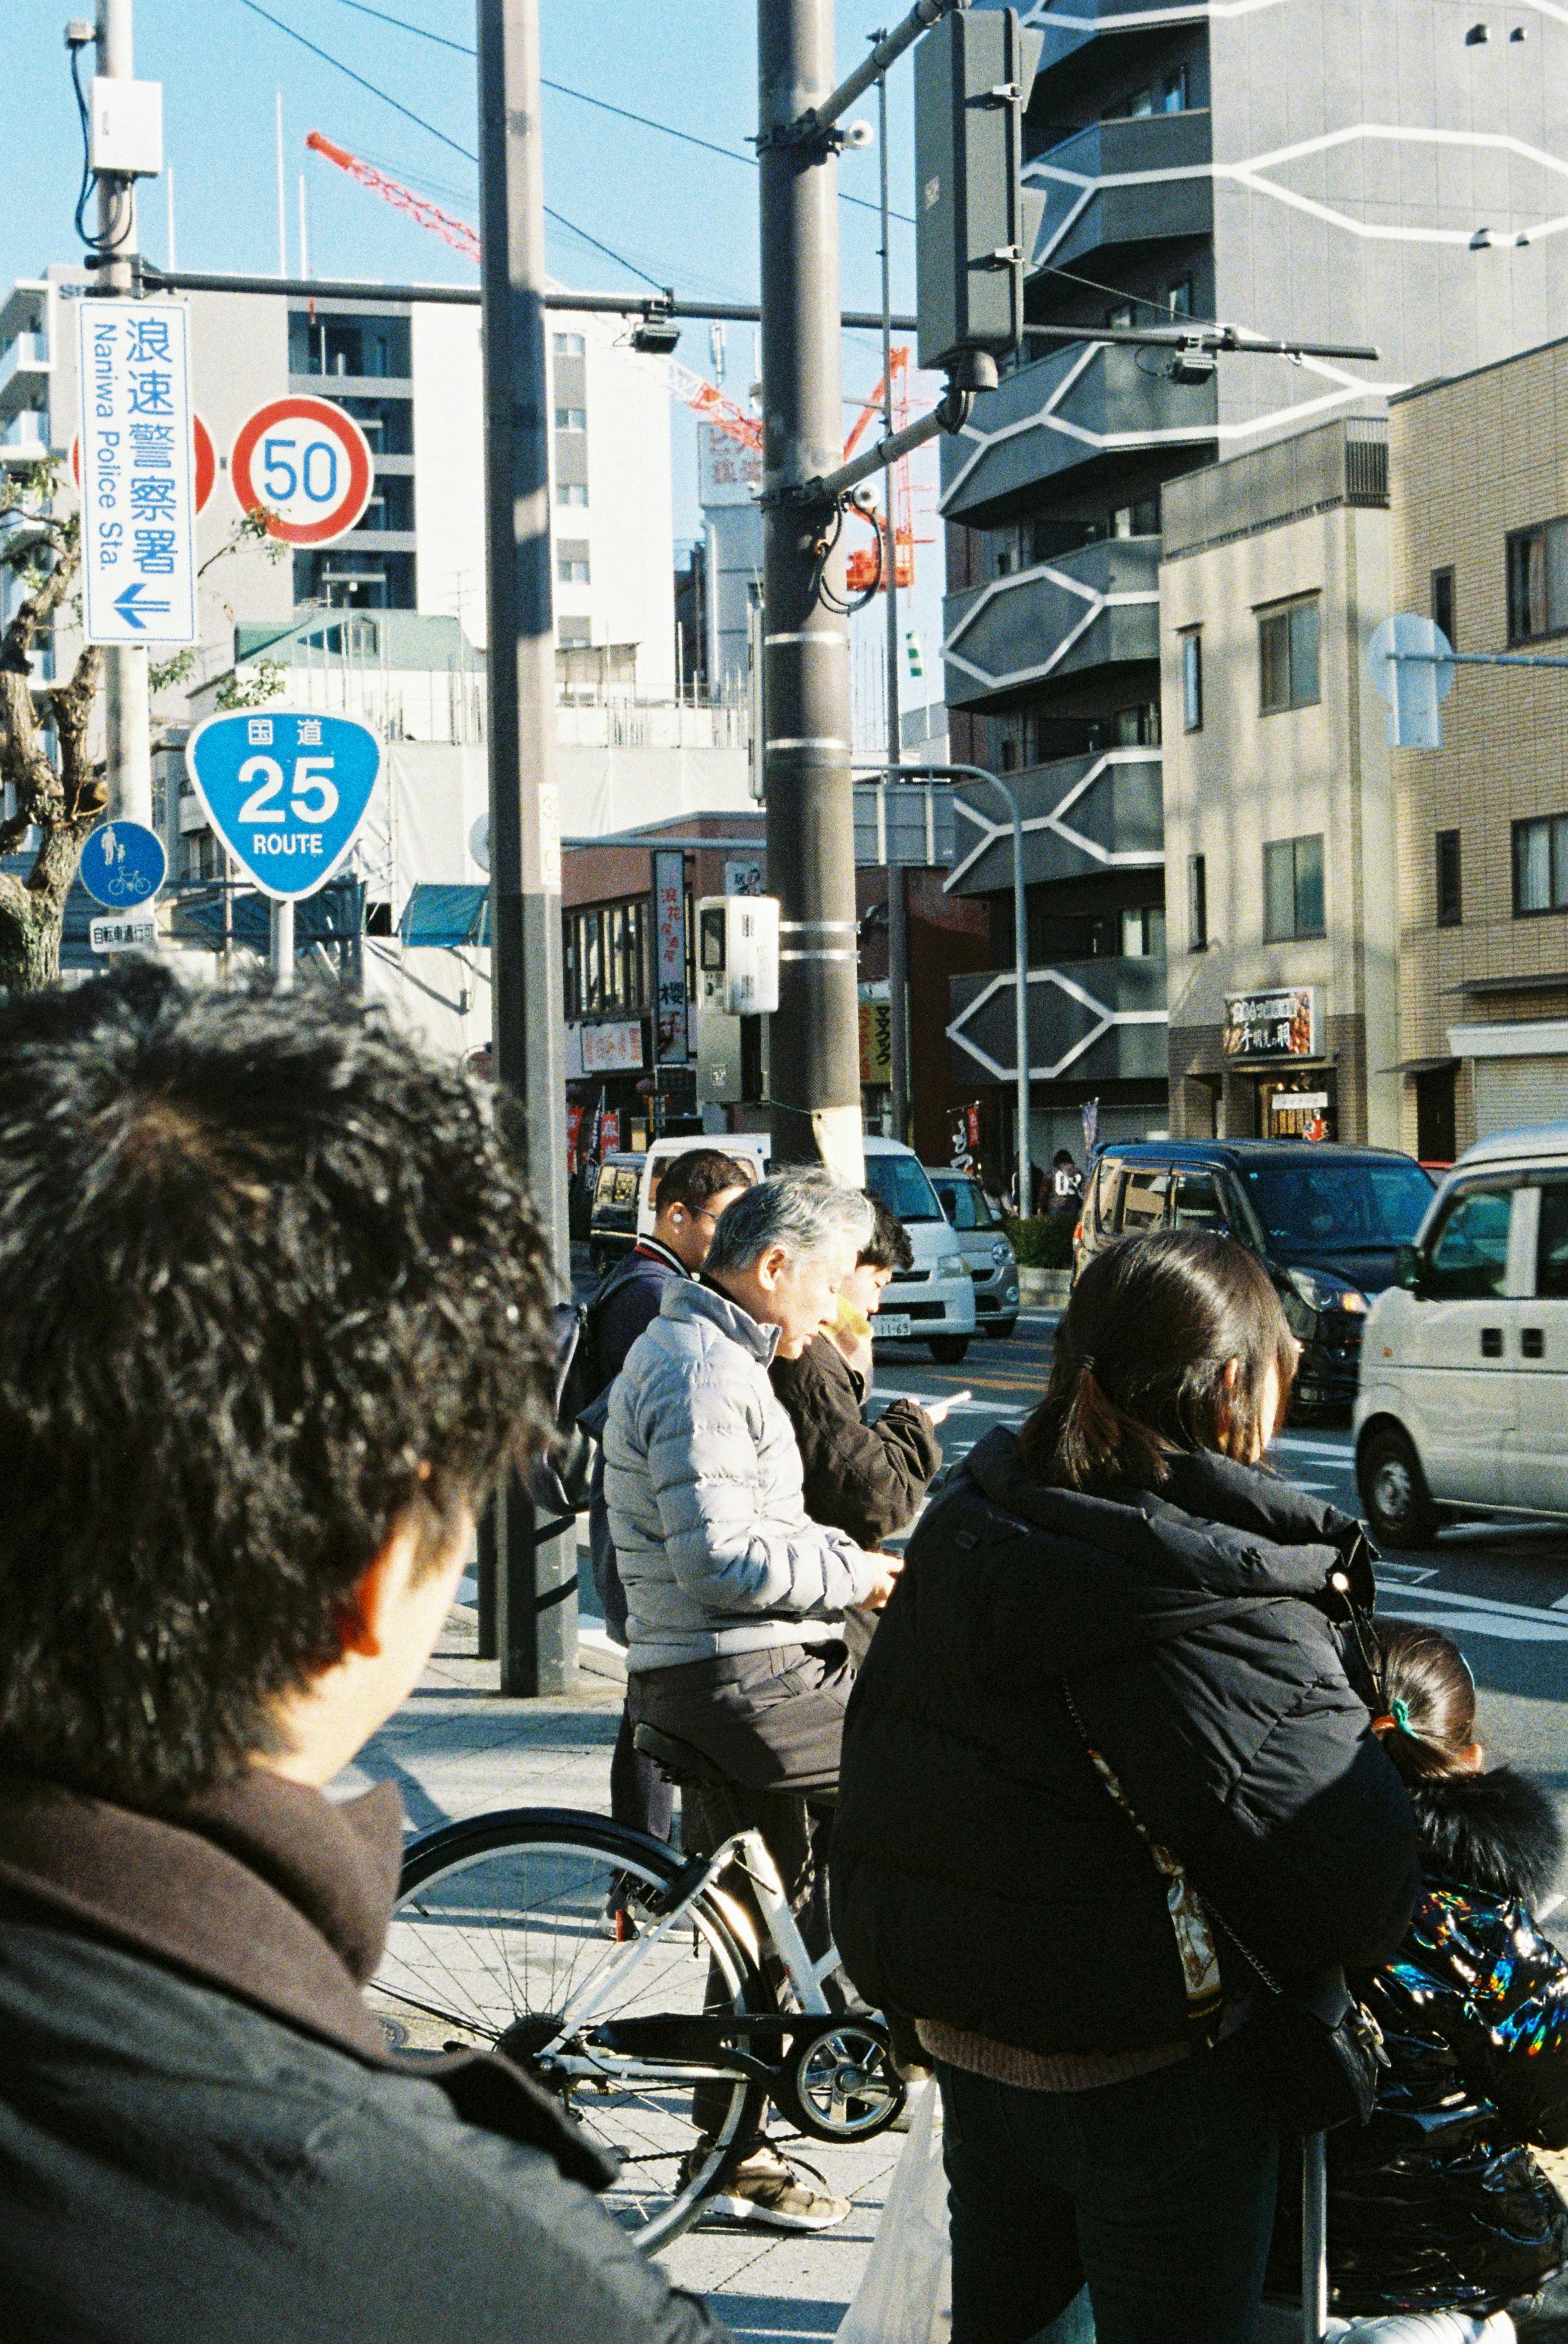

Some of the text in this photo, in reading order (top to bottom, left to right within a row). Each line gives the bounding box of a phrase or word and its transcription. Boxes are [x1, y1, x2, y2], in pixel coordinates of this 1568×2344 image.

[93, 323, 123, 571] Naniwa Police Sta.
[126, 316, 179, 575] 浪速警察署
[264, 438, 337, 503] 50
[247, 719, 324, 746] 国道
[237, 755, 339, 824] 25
[253, 833, 324, 855] ROUTE
